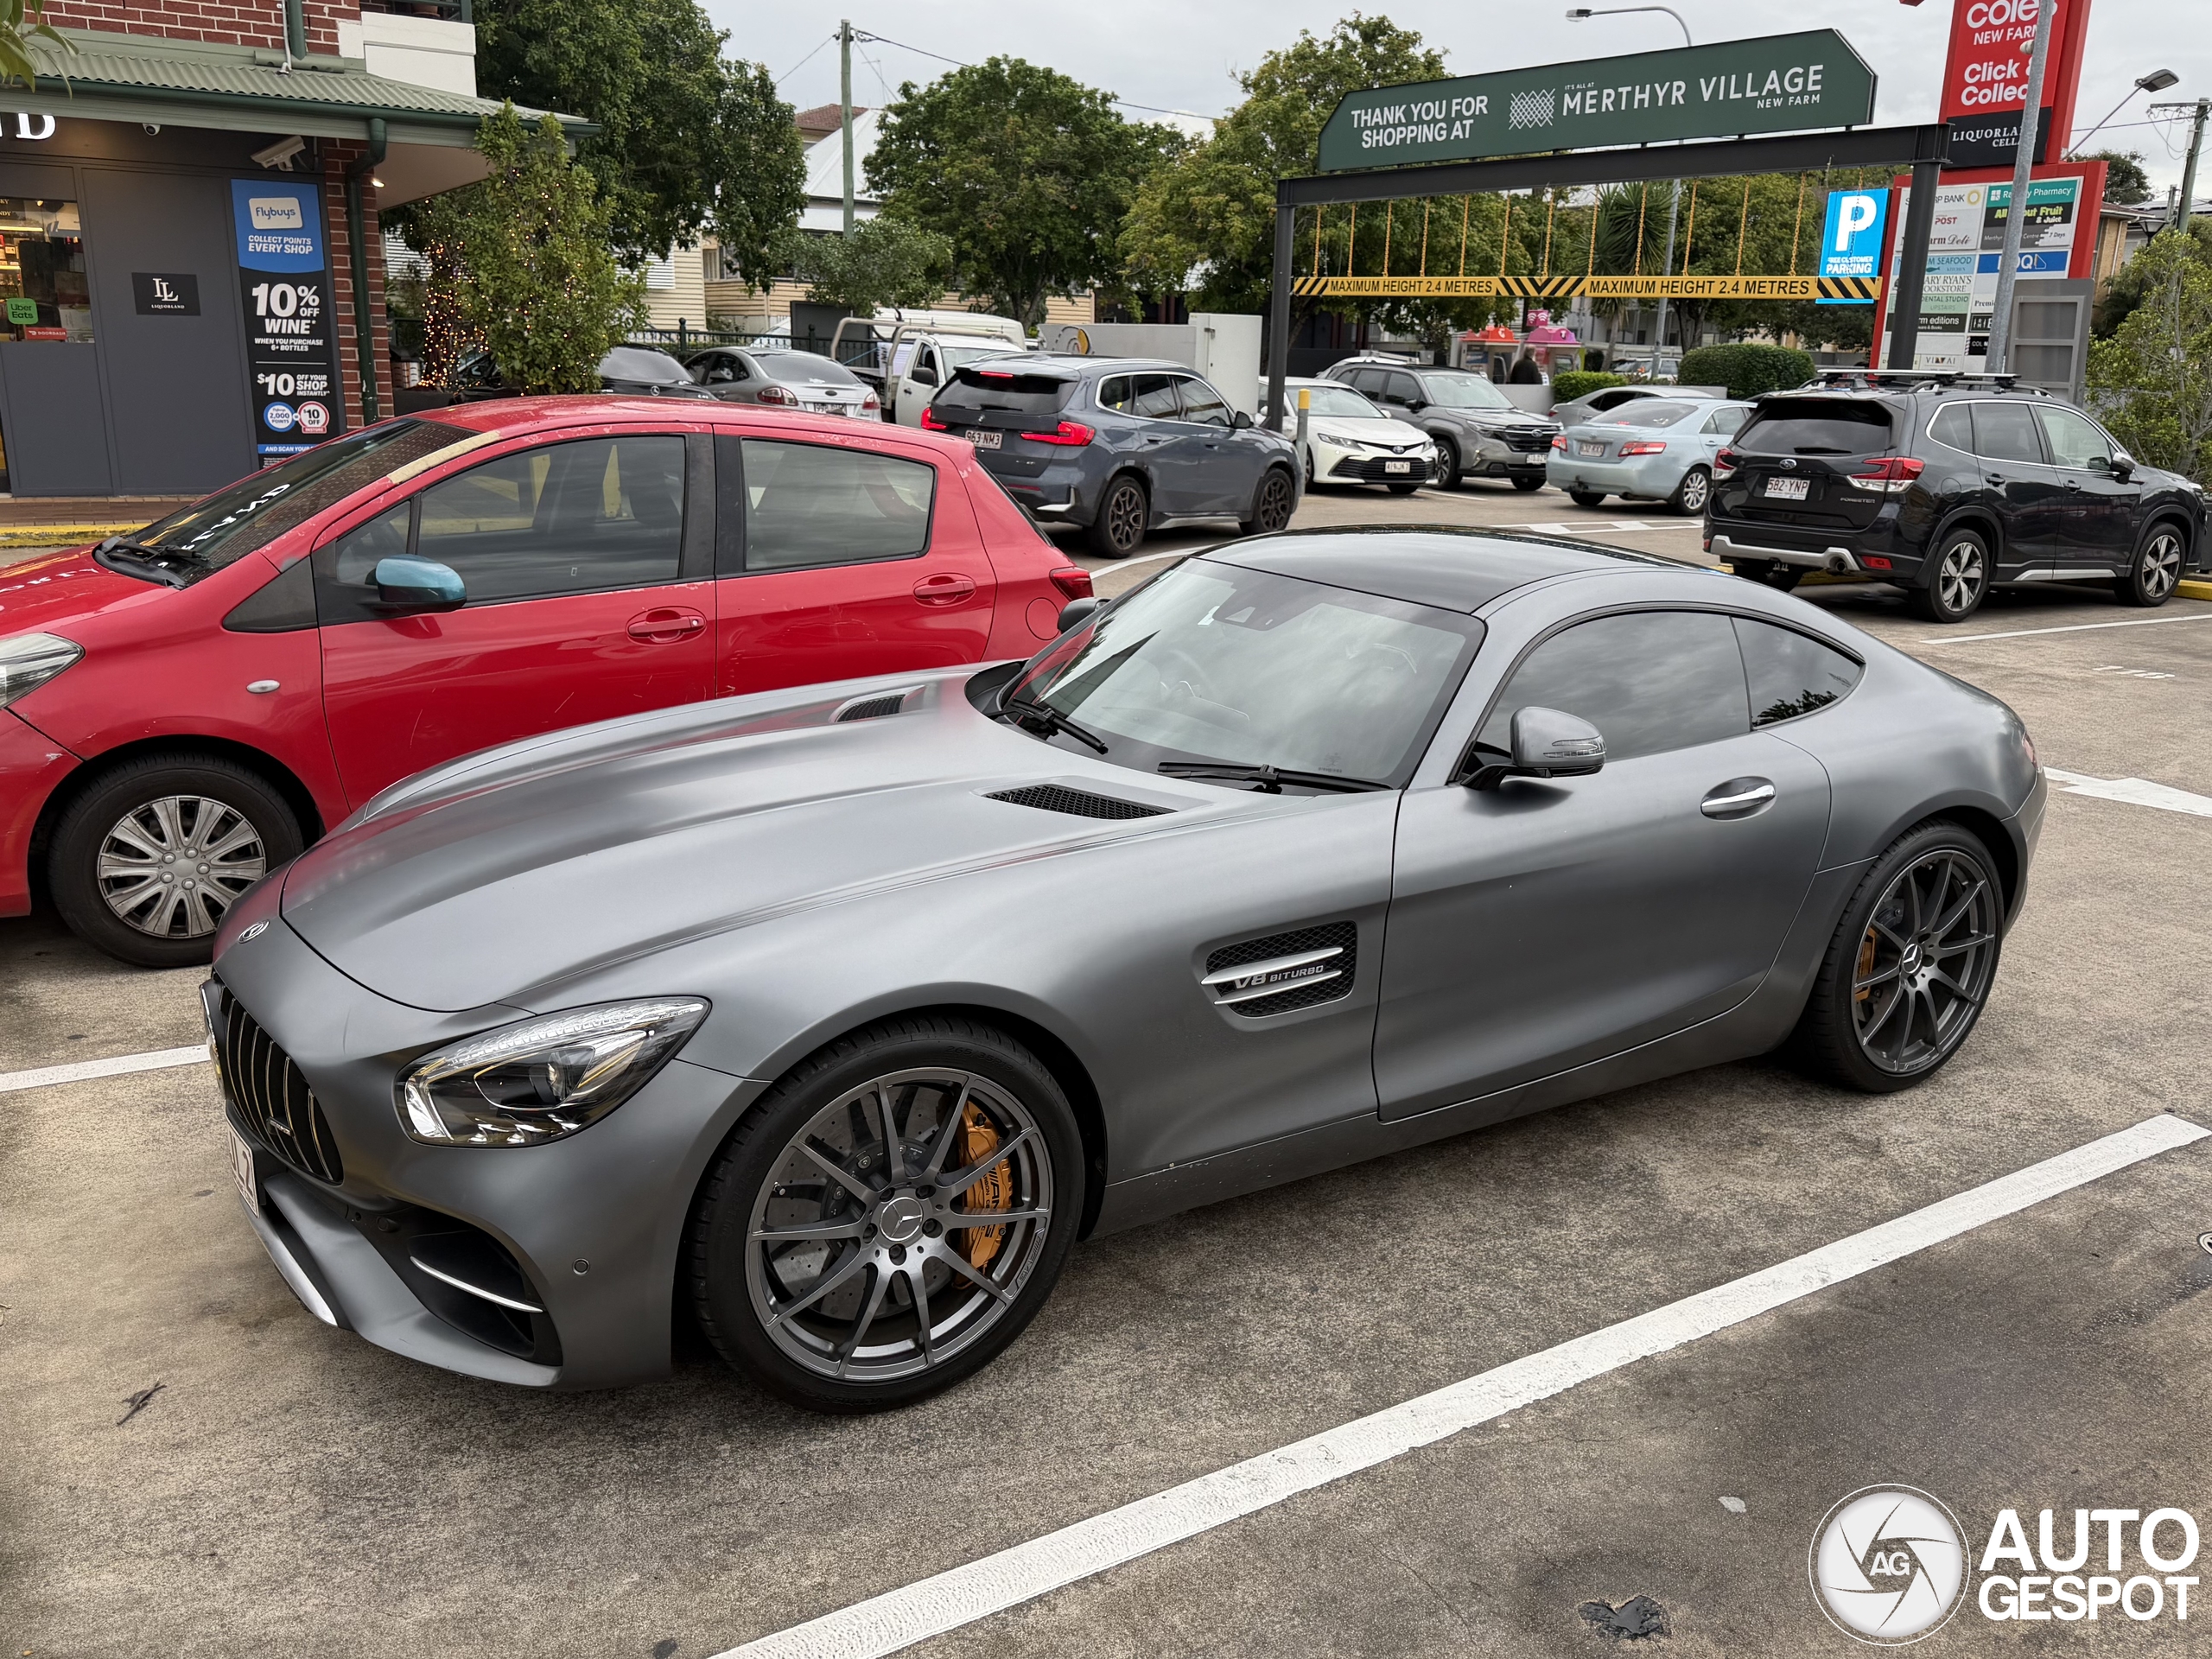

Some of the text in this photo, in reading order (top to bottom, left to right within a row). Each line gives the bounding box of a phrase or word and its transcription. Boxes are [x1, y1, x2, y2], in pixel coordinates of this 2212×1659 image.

[1974, 29, 2004, 45] NEW
[1964, 59, 2020, 84] Click
[1562, 65, 1824, 116] MERTHYR VILLAGE
[1961, 83, 2028, 106] Collec
[1757, 94, 1821, 109] NEW FARM
[1351, 95, 1488, 128] THANK YOU FOR
[1361, 119, 1474, 149] SHOPPING AT
[1952, 127, 2022, 143] LIQUORLA
[1944, 194, 1965, 203] BANK
[2033, 188, 2071, 197] Pharmacy
[255, 207, 296, 219] flybuys
[1994, 209, 2007, 219] All
[2039, 206, 2063, 216] Fruit
[1835, 195, 1877, 251] P
[248, 235, 283, 244] COLLECT
[248, 243, 313, 254] EVERY SHOP
[1937, 257, 1972, 265] SEAFOOD
[1826, 263, 1872, 274] PARKING
[1330, 281, 1492, 293] MAXIMUM HEIGHT 2.4 METRES
[1589, 281, 1809, 295] MAXIMUM HEIGHT 2.4 METRES
[251, 283, 320, 317] 10%
[300, 308, 320, 317] OFF
[1929, 315, 1960, 325] editions
[257, 373, 295, 396] $10
[296, 381, 327, 391] SHOP
[303, 409, 320, 419] $10
[1269, 965, 1324, 982] BITURBO
[1234, 973, 1266, 989] V8
